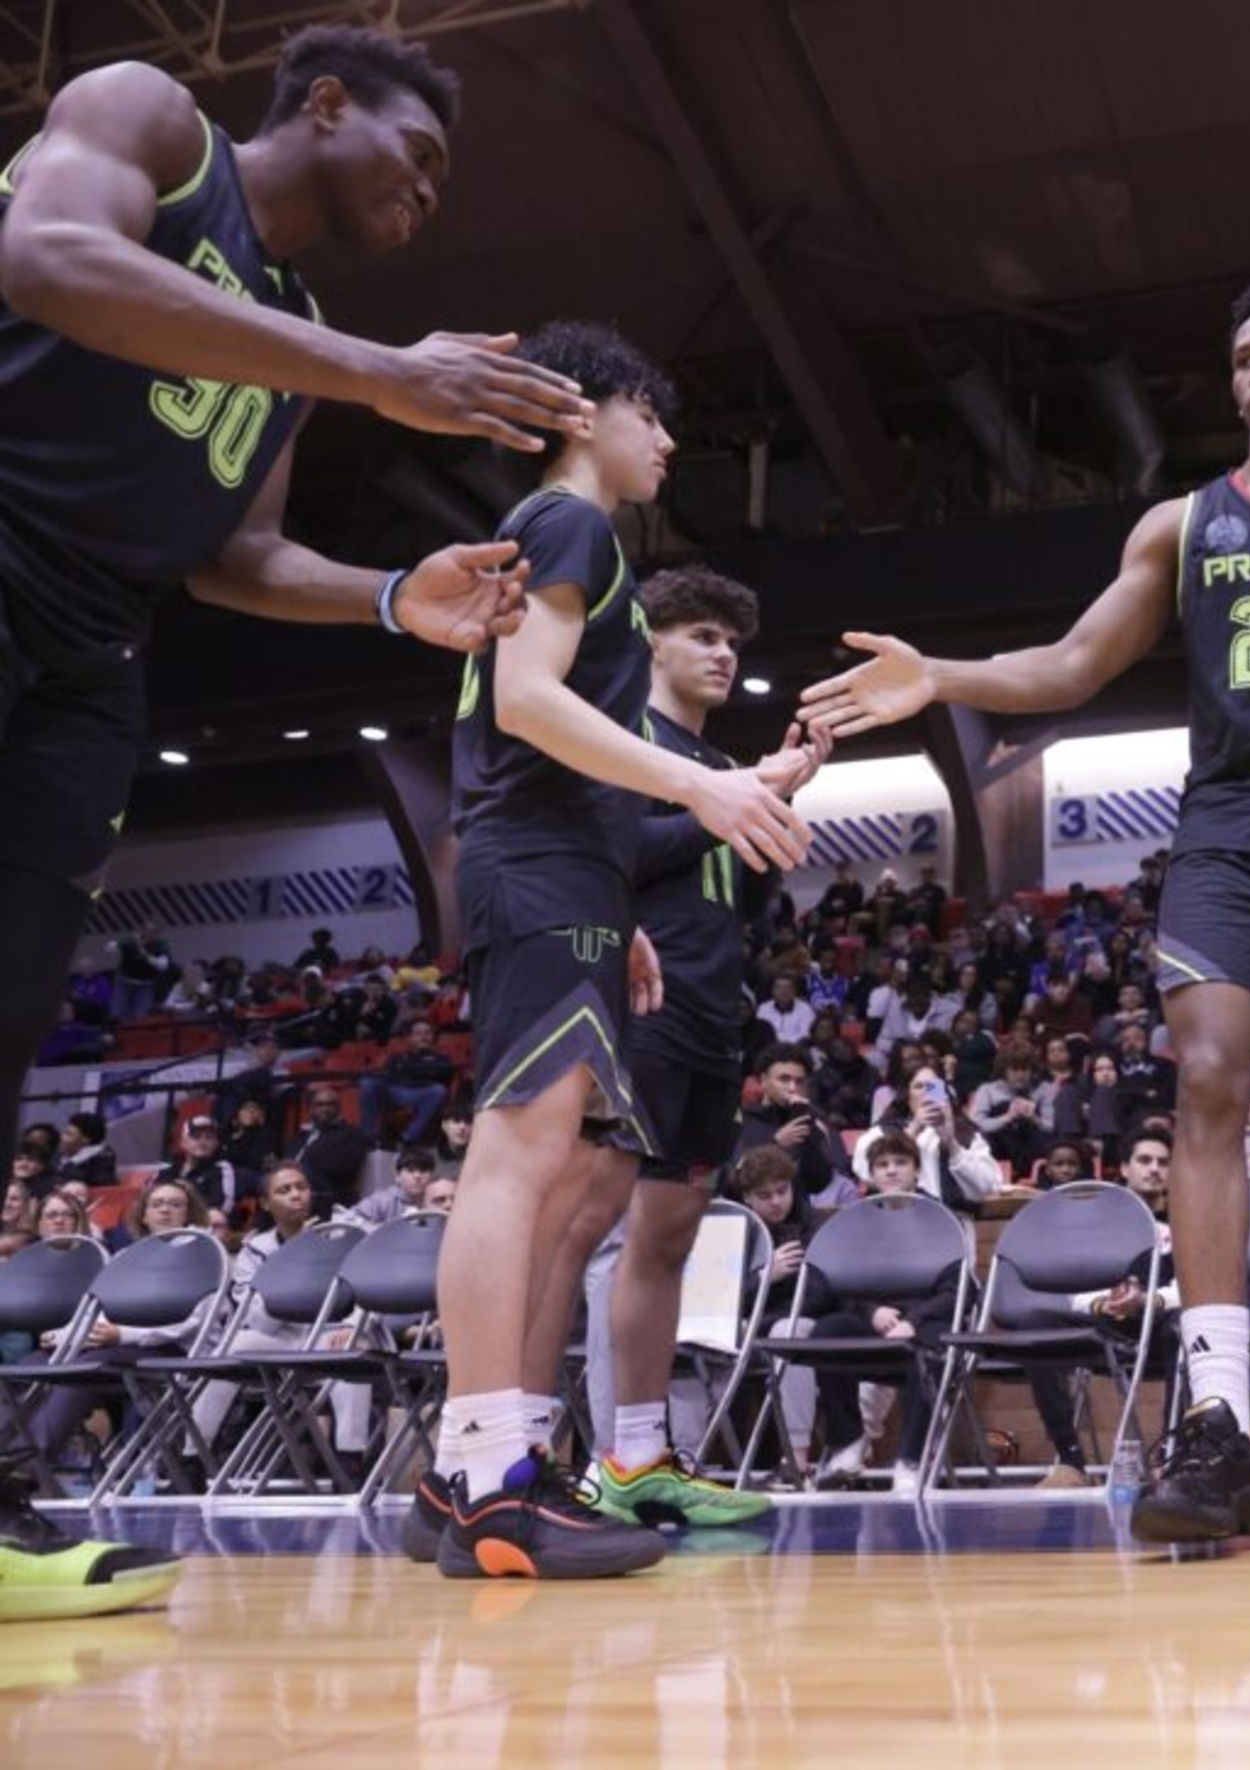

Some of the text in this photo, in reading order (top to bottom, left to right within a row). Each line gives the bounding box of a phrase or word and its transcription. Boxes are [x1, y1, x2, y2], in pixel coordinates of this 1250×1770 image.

[909, 813, 938, 851] 2
[1057, 798, 1088, 840] 3
[256, 878, 272, 916] 1
[362, 867, 388, 905] 2
